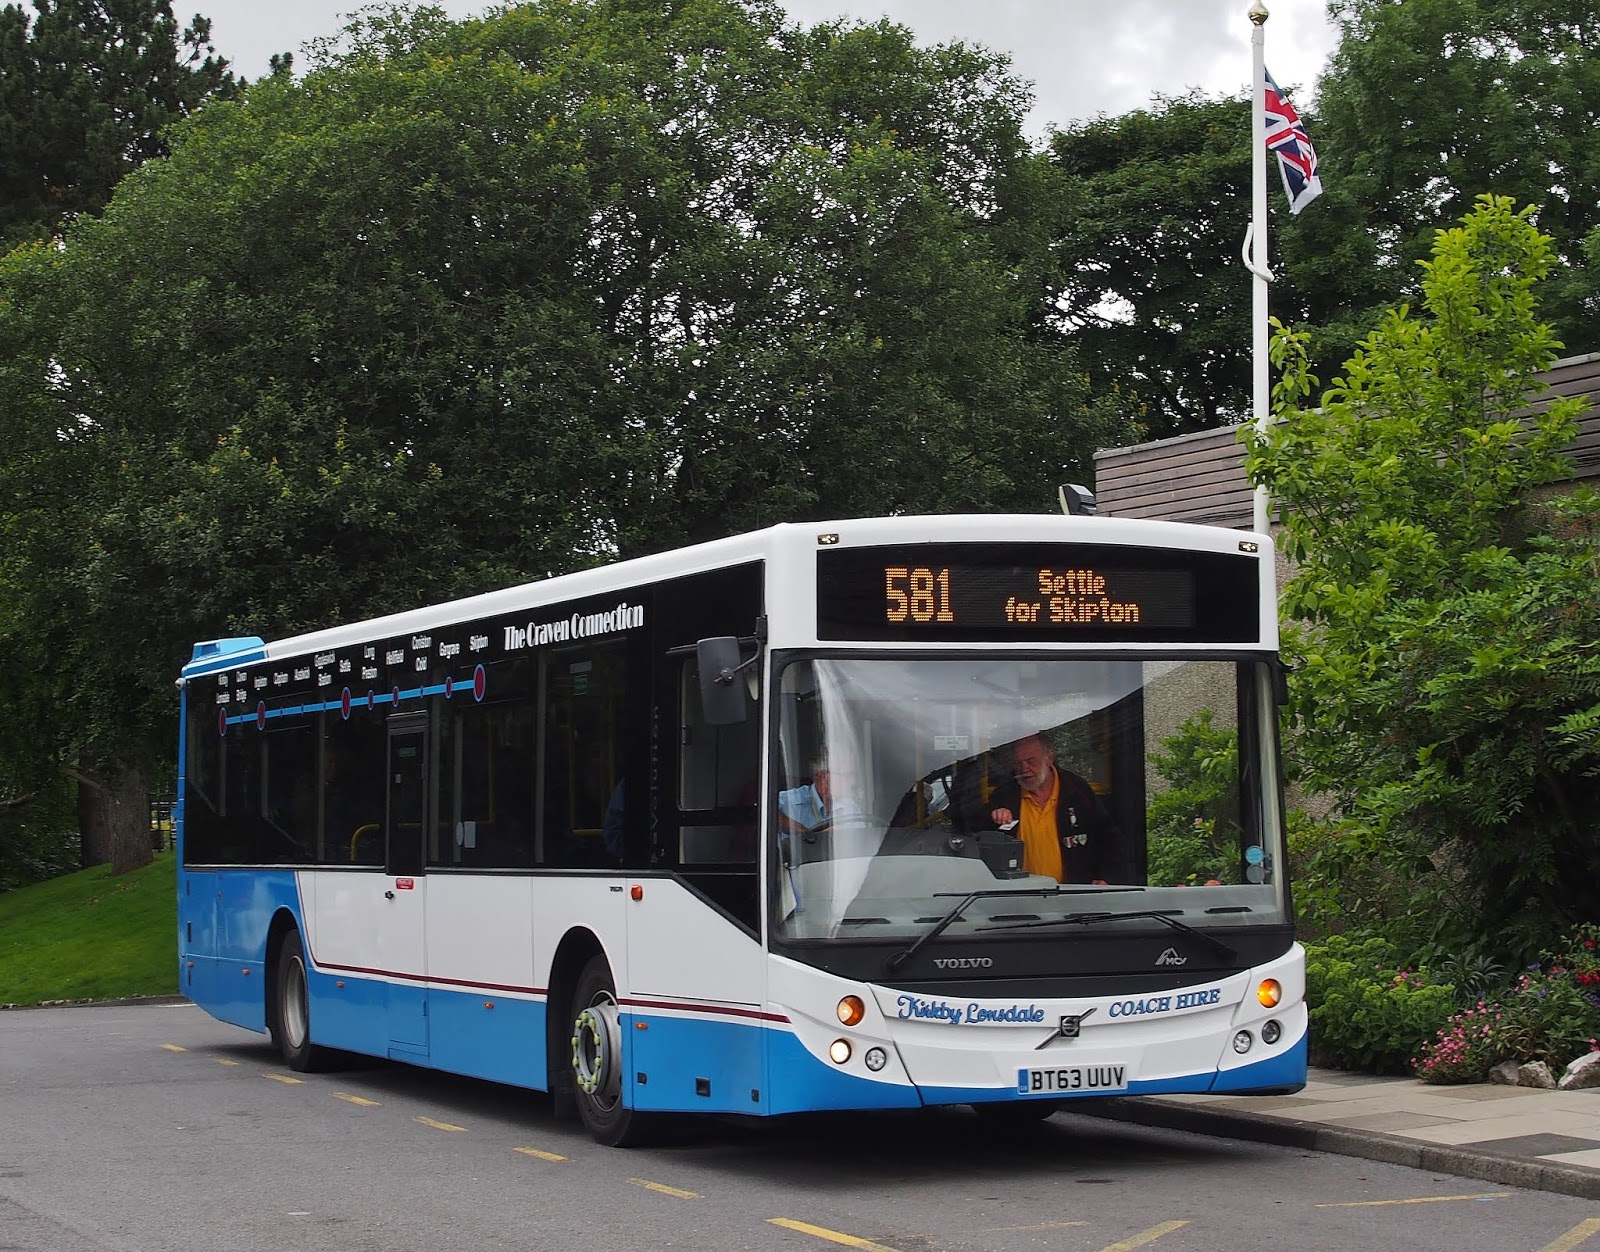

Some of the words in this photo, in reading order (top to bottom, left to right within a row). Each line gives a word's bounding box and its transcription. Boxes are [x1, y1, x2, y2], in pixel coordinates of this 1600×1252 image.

[884, 567, 955, 622] 581
[1038, 569, 1107, 595] Settle
[1005, 597, 1042, 622] for
[1049, 597, 1140, 623] Skipton
[504, 626, 525, 650] The
[526, 620, 569, 647] Craven
[571, 603, 643, 639] Connection
[933, 957, 994, 969] VOLVO
[1165, 957, 1188, 966] MCV
[897, 994, 963, 1025] Kirkby
[965, 1003, 1045, 1024] Lonsdale
[1109, 996, 1172, 1018] COACH
[1175, 988, 1221, 1010] HIRE
[1031, 1069, 1081, 1092] BT63
[1087, 1066, 1124, 1088] UUV
